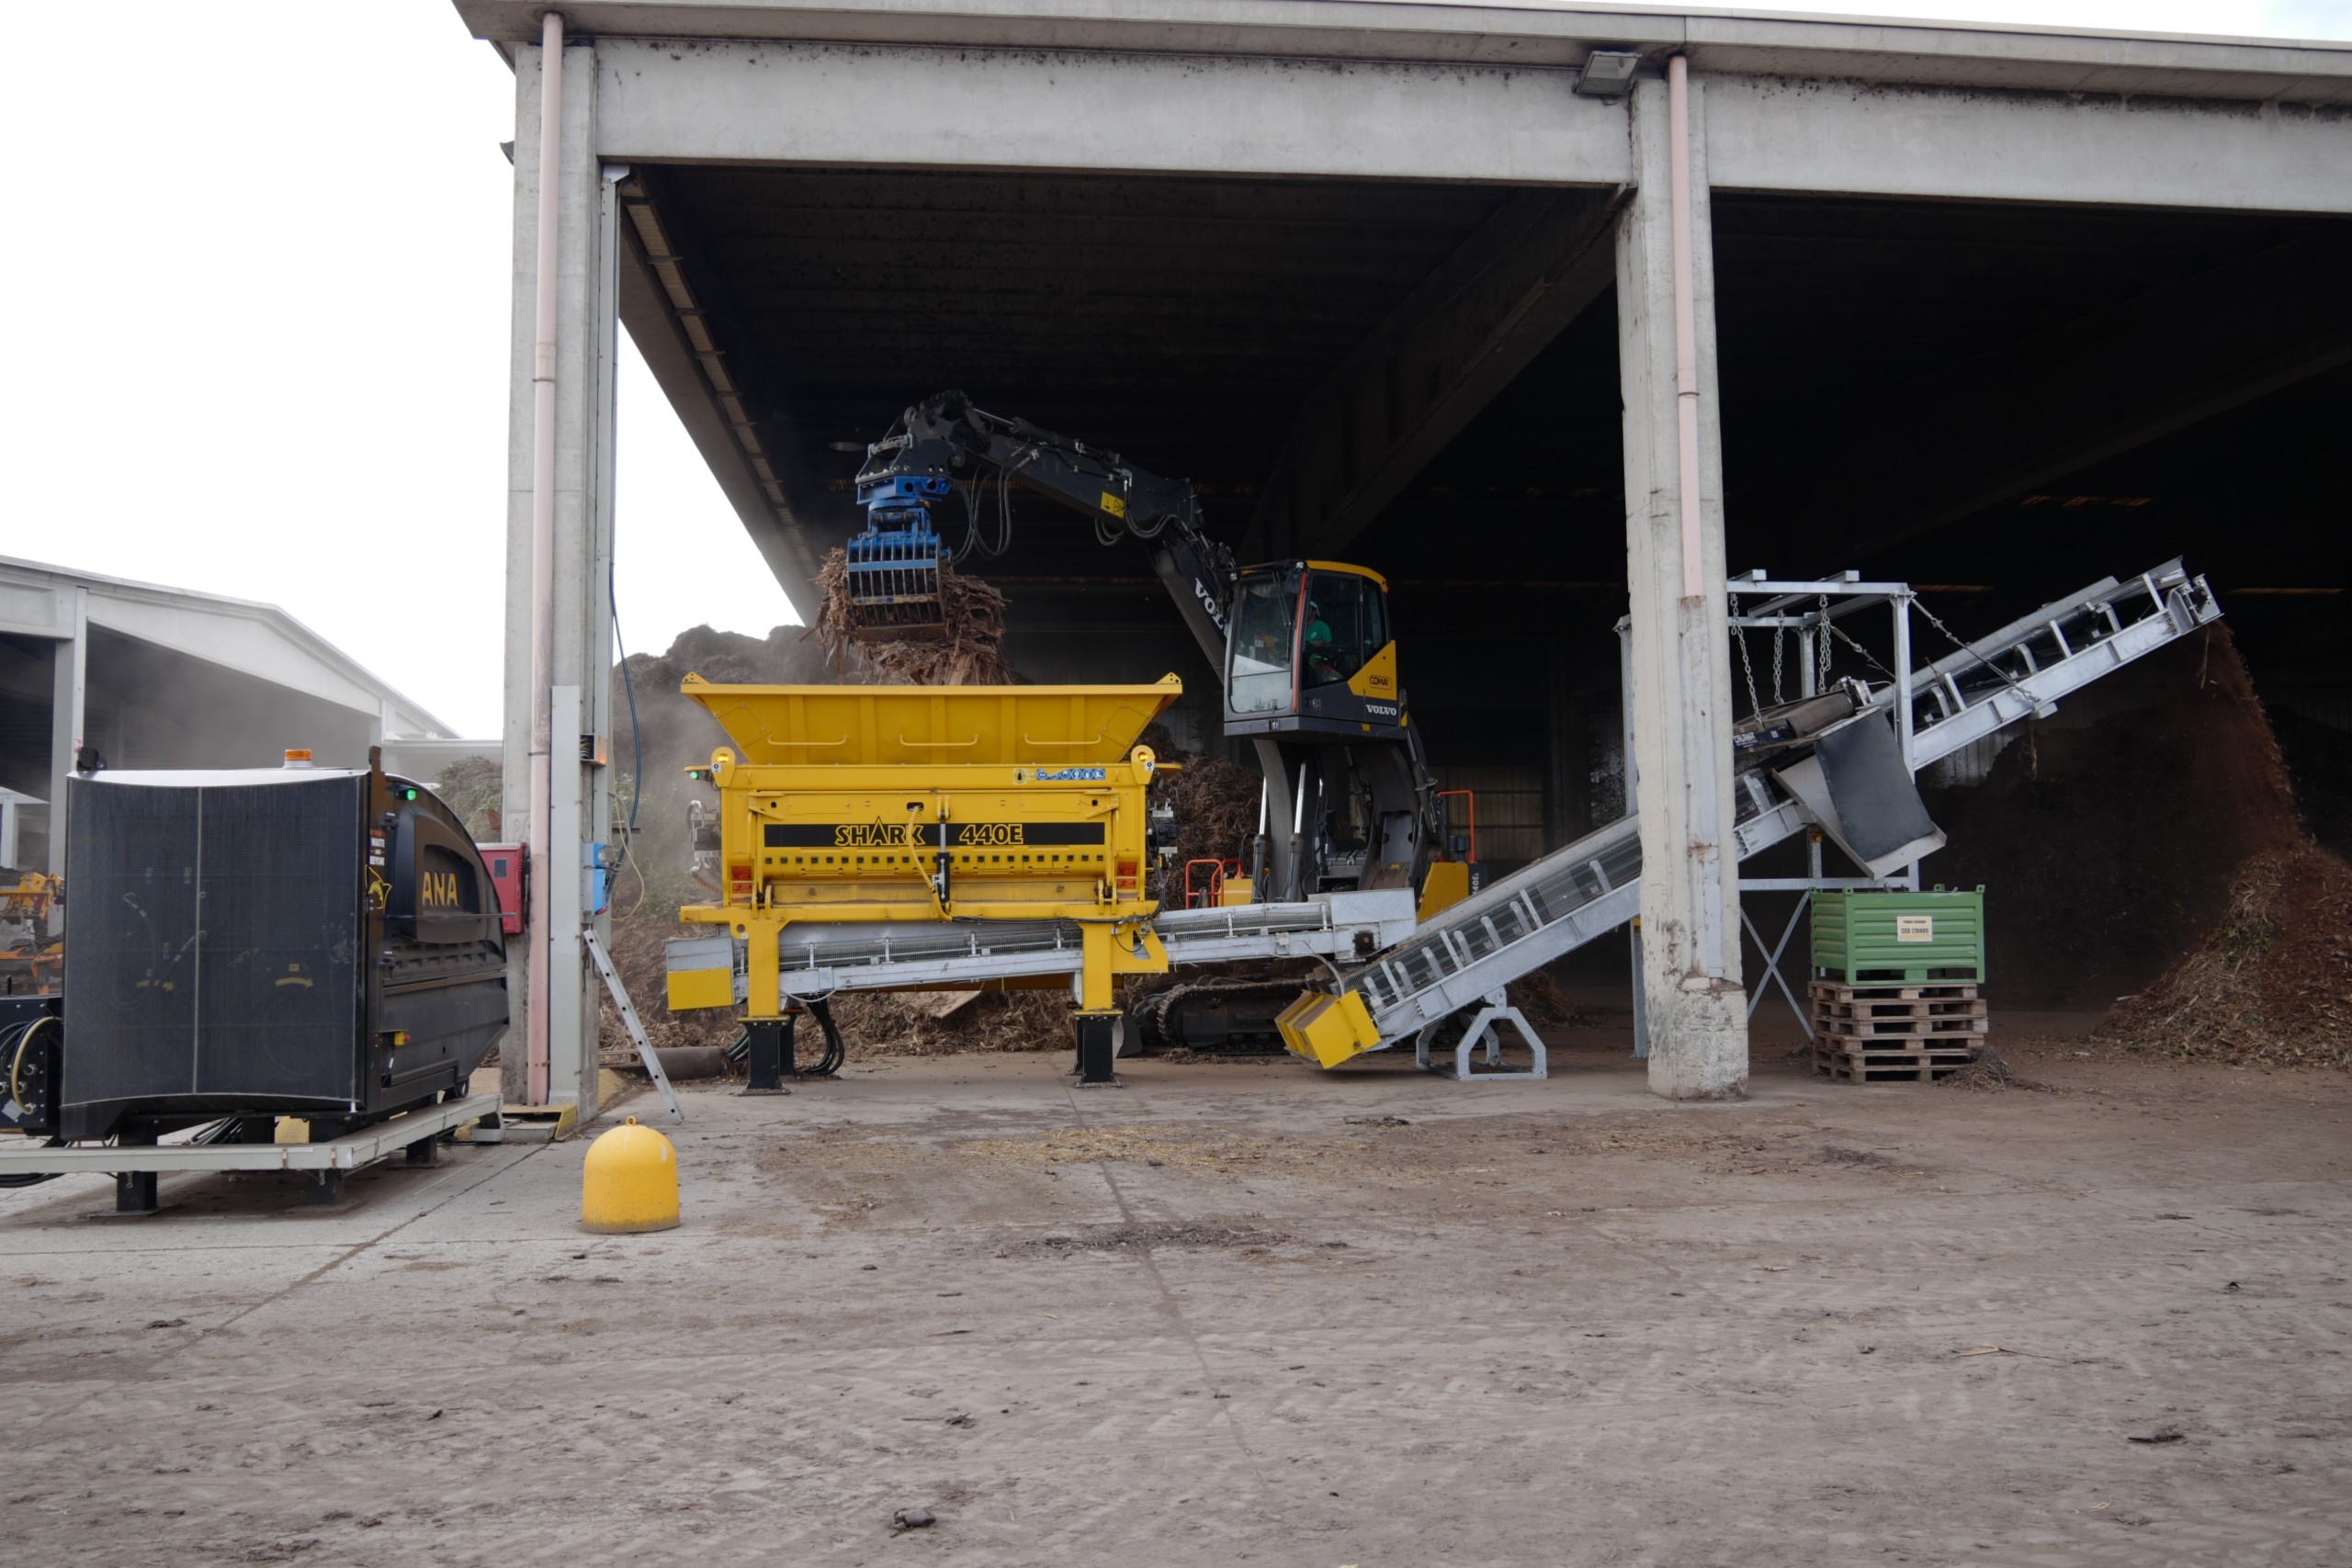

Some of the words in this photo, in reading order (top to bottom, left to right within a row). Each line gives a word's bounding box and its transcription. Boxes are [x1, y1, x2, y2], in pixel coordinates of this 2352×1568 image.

[1195, 577, 1230, 639] VOL
[1366, 705, 1396, 716] VOLVO
[835, 816, 926, 846] SHARK
[959, 824, 1023, 844] 440E
[423, 872, 459, 906] ANA
